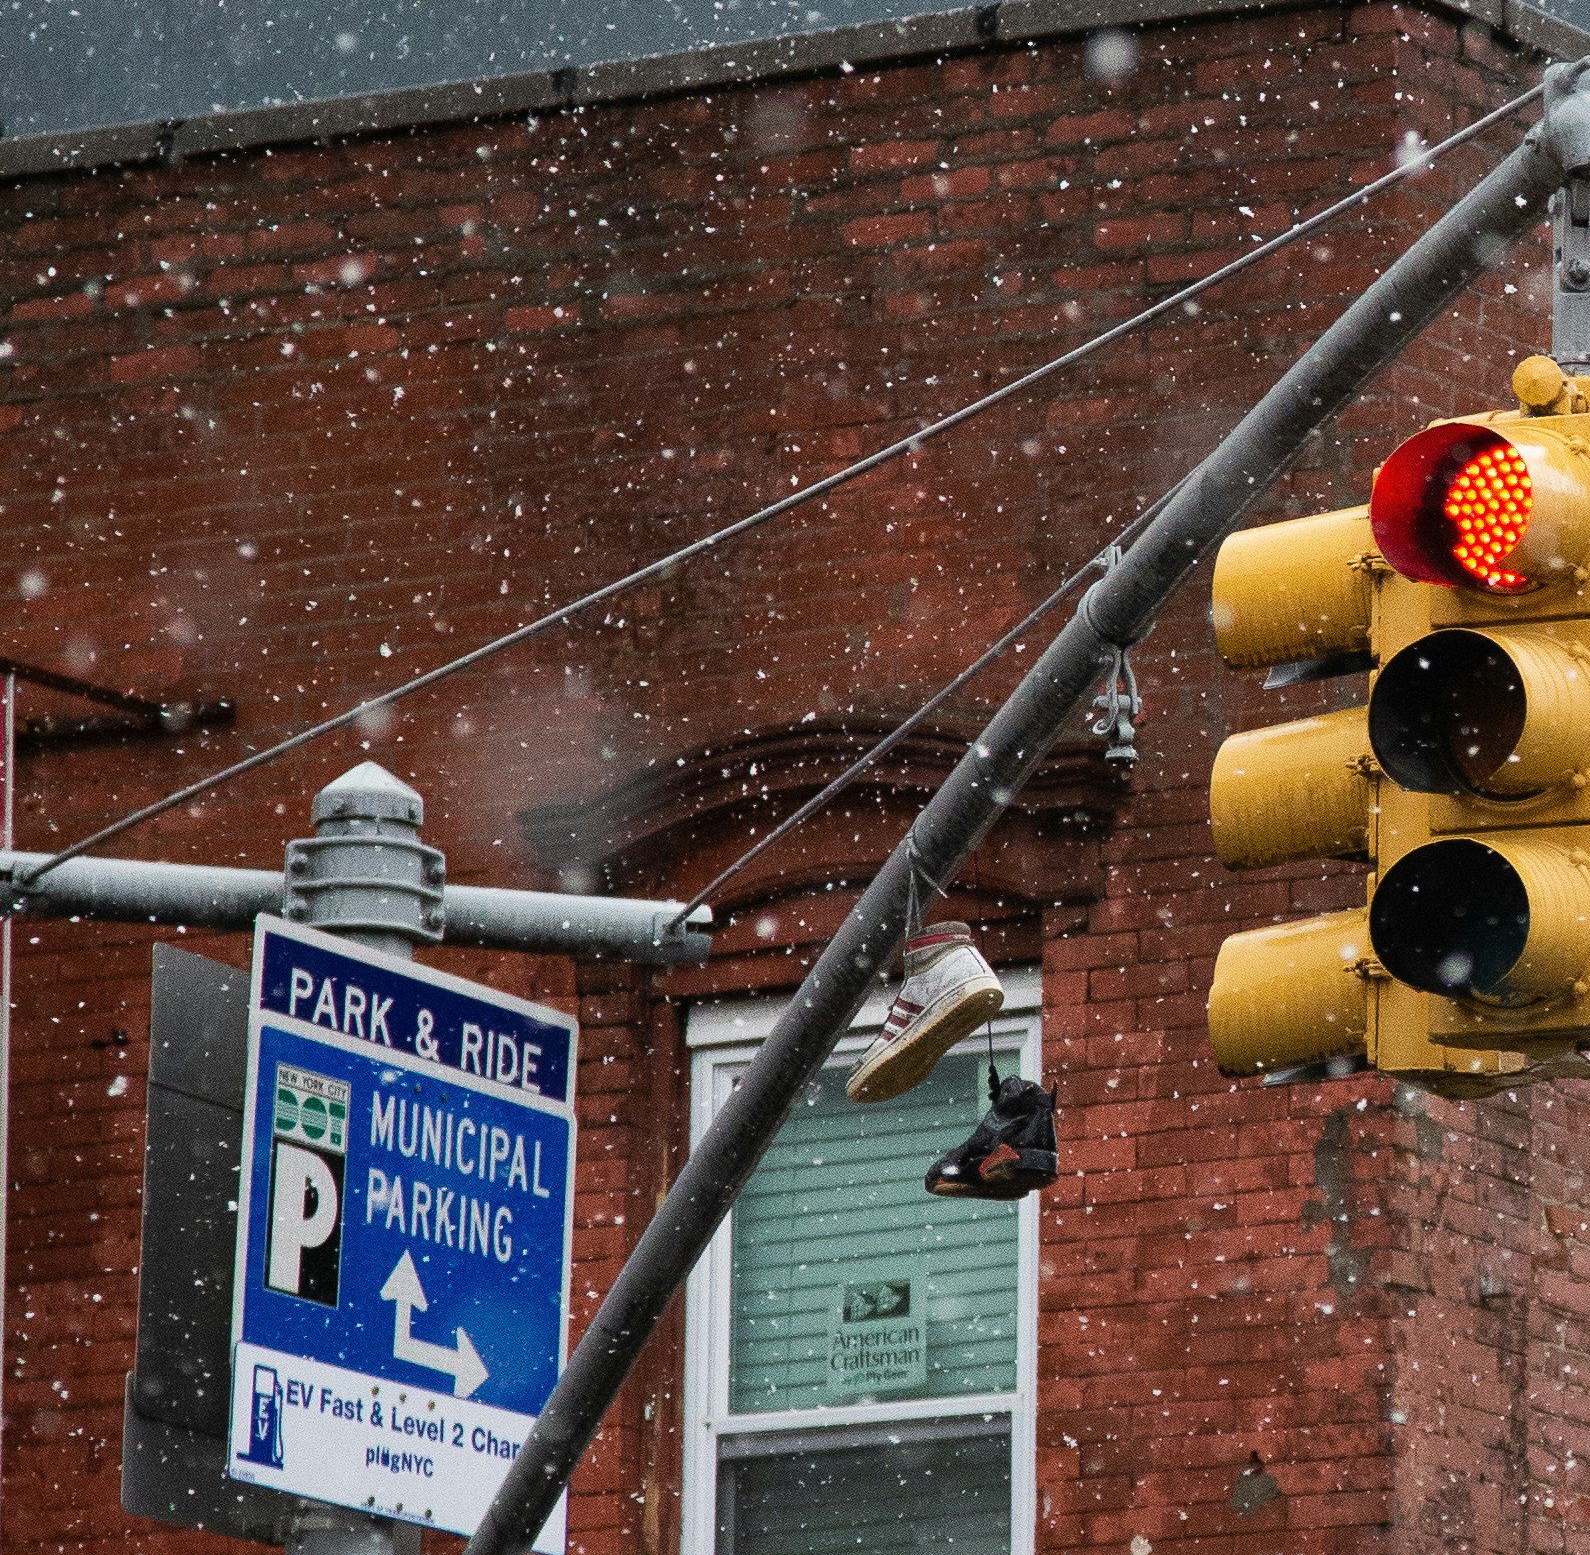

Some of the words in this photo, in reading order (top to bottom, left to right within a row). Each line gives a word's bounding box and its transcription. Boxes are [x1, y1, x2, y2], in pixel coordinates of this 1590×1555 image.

[288, 966, 395, 1047] PARK
[414, 1007, 440, 1062] &
[459, 1021, 543, 1094] RIDE
[327, 1083, 347, 1100] CITY
[369, 1089, 550, 1199] MUNICIPAL
[268, 1141, 339, 1294] P
[365, 1166, 513, 1264] PARKING
[830, 1349, 920, 1371] Craftsman
[833, 1327, 919, 1350] American
[286, 1378, 314, 1409] EV
[320, 1391, 364, 1423] Fast
[369, 1400, 384, 1428] &
[391, 1406, 445, 1444] Level
[452, 1421, 464, 1448] 2
